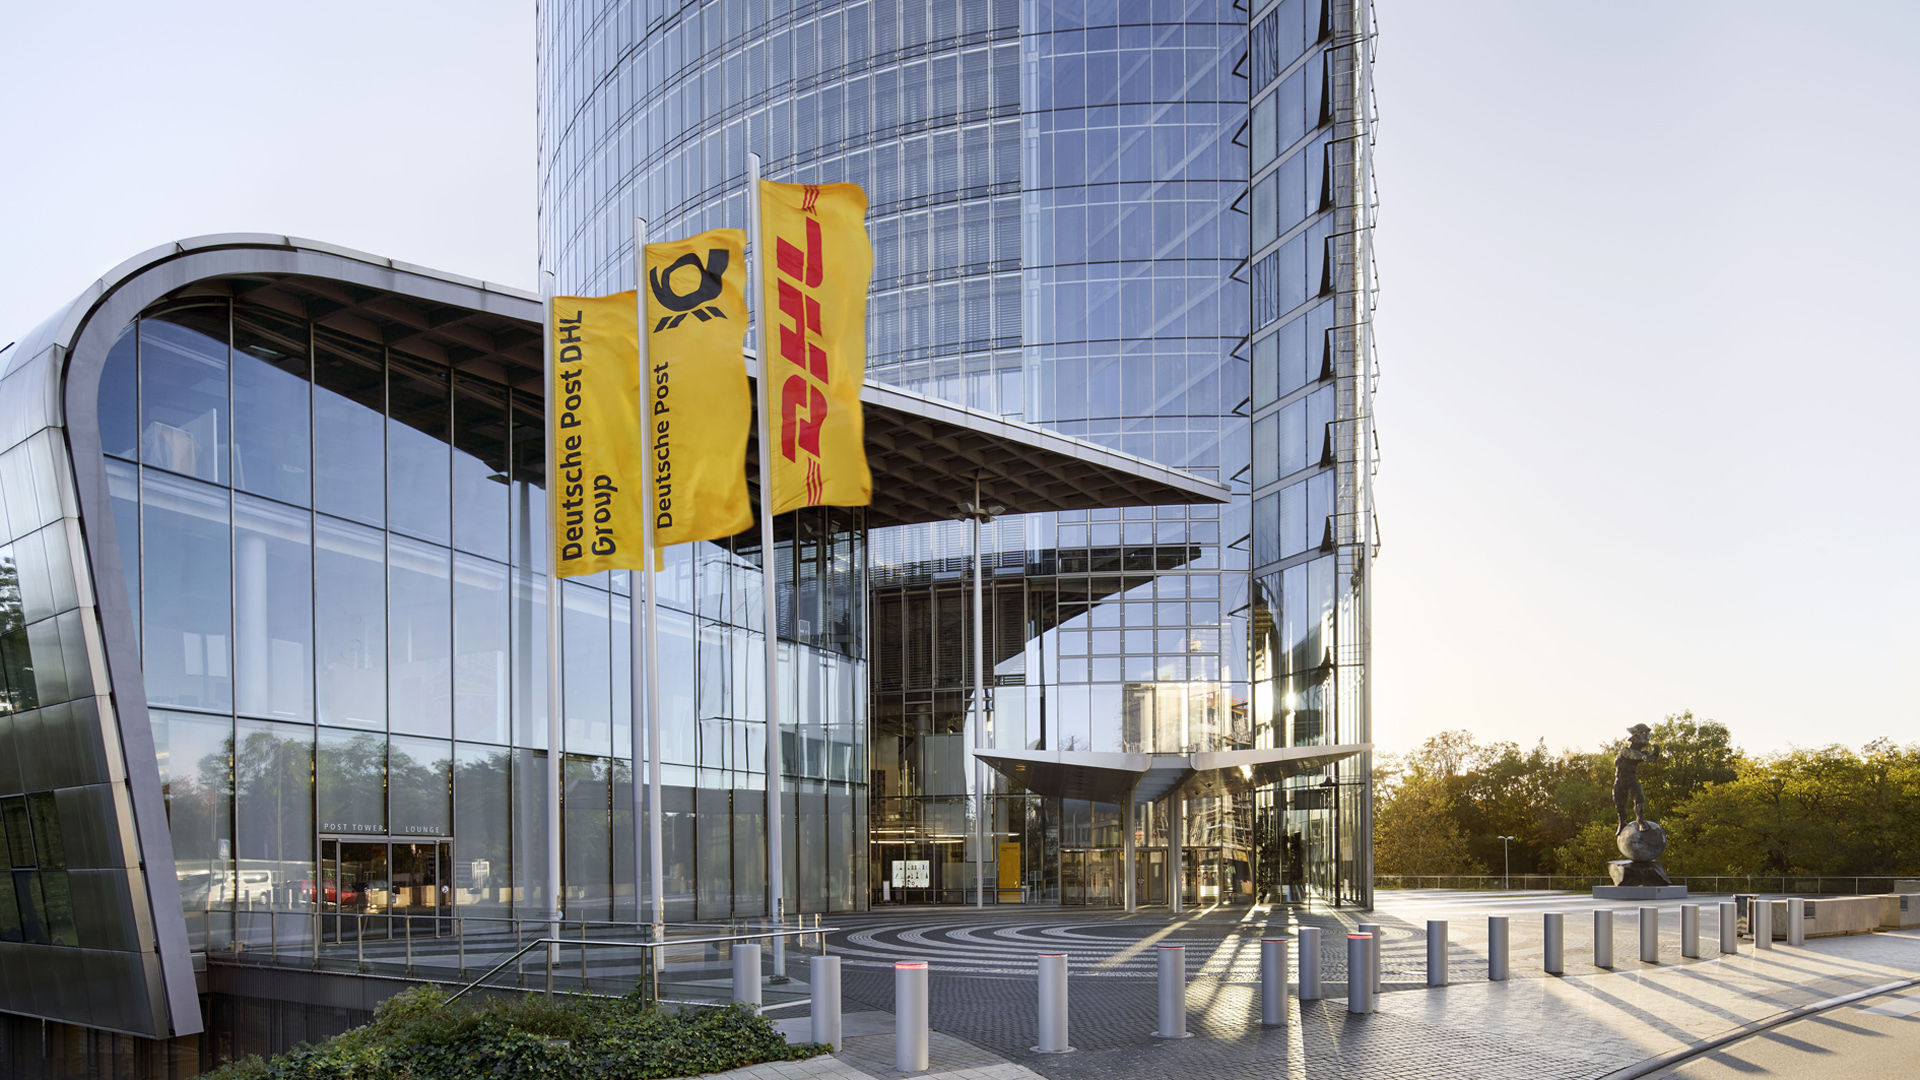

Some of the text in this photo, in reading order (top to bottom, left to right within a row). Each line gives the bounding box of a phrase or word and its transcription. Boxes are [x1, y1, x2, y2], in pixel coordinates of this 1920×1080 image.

[776, 216, 829, 463] DHL
[559, 310, 584, 561] Deutsche Post DHL
[591, 474, 618, 556] Group
[653, 361, 673, 529] Deutsche Post
[323, 823, 440, 834] POST TOWER LOUNGE
